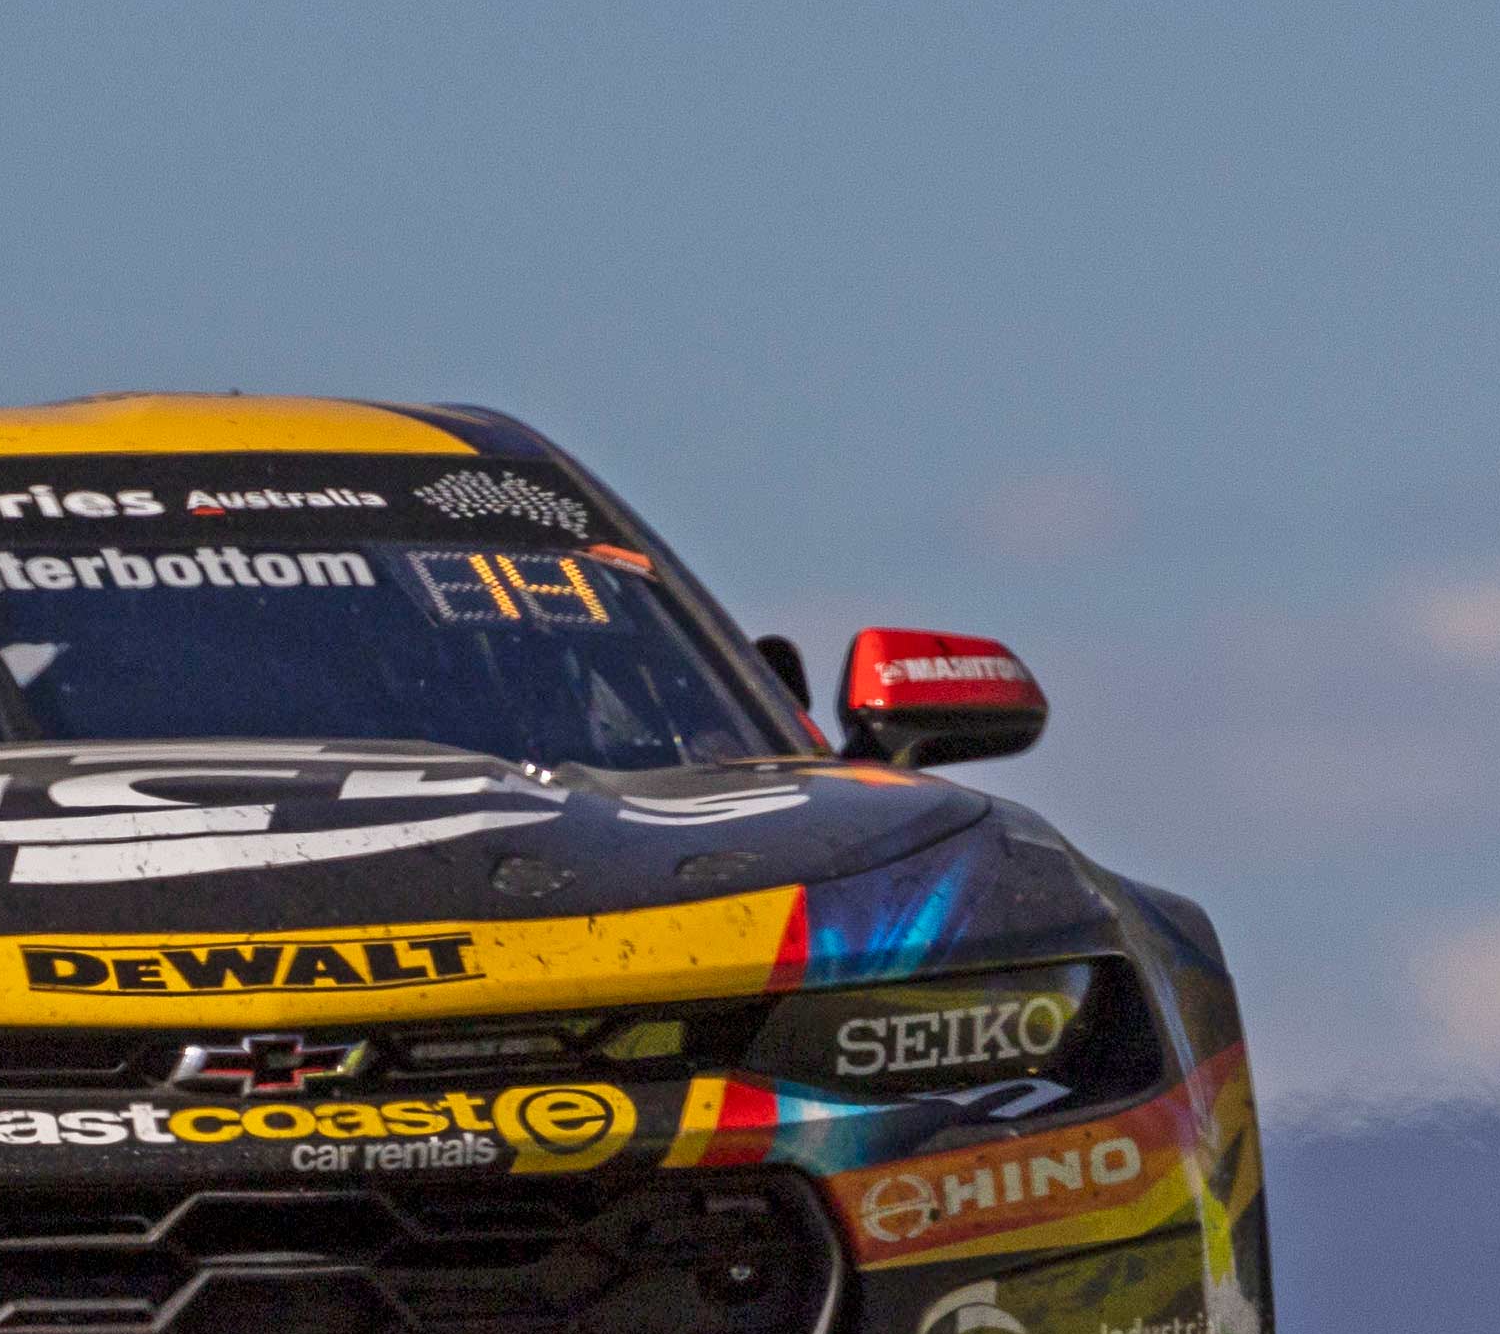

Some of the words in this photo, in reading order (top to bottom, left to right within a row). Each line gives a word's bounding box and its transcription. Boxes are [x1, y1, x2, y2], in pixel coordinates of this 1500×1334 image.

[187, 485, 388, 515] Australia
[25, 933, 477, 993] DEWALT
[834, 996, 1066, 1077] SEIKO
[291, 1140, 357, 1173] car
[364, 1131, 499, 1171] rentals
[939, 1136, 1143, 1216] HINO
